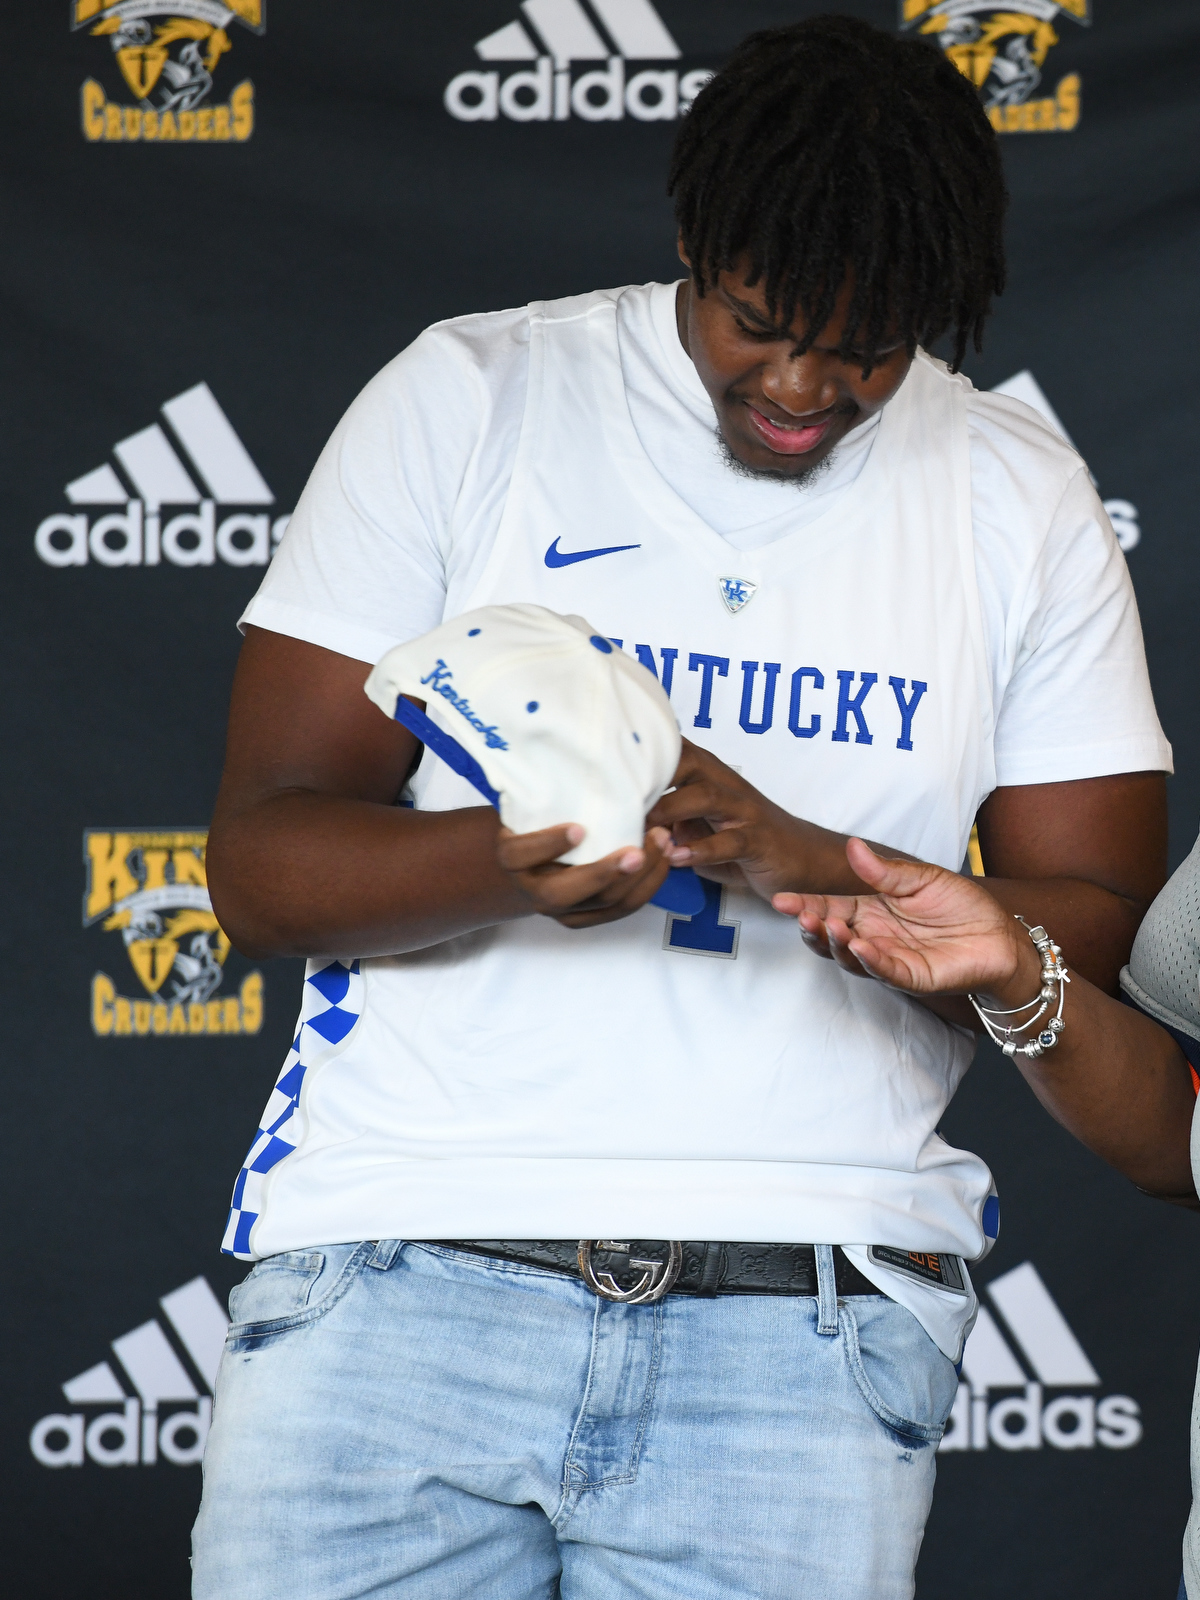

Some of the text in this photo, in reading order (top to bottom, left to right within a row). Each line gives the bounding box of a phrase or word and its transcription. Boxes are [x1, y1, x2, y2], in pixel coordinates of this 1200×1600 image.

[81, 78, 255, 141] CRUSADERS
[34, 499, 293, 567] adida
[420, 659, 508, 751] Kentucky
[86, 832, 208, 920] KIN
[91, 972, 264, 1036] CRUSADERS
[30, 1396, 213, 1469] adid
